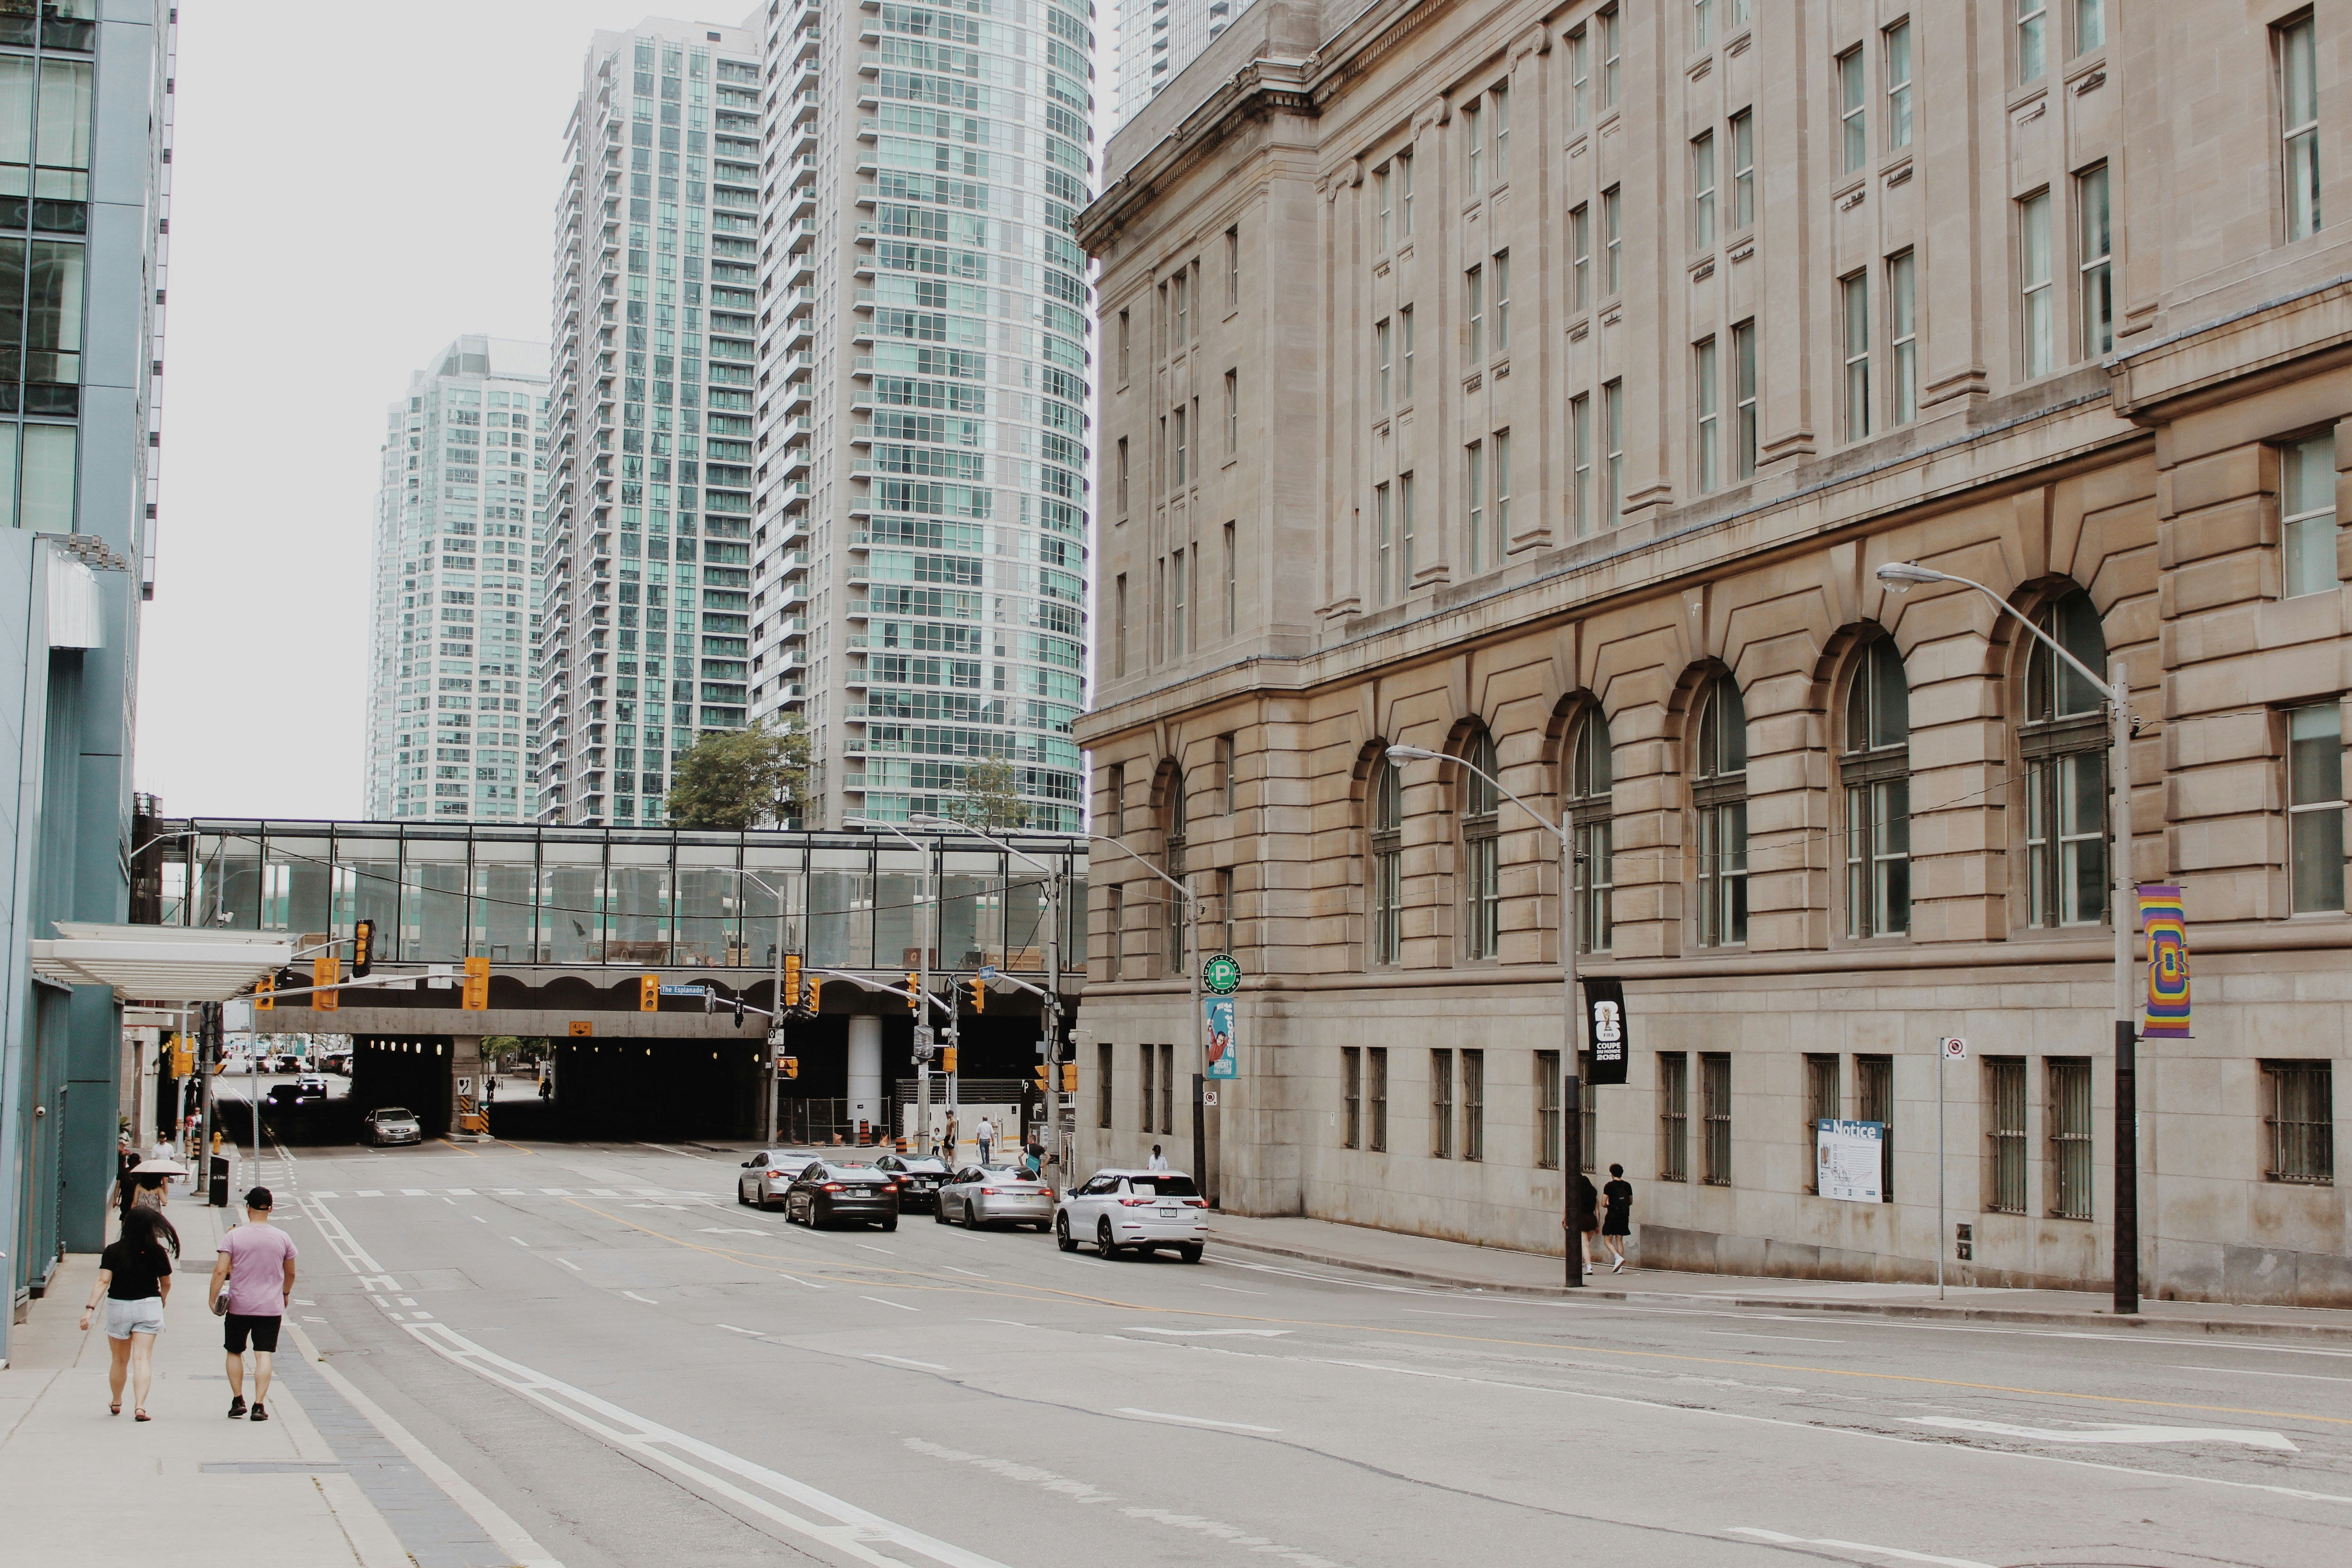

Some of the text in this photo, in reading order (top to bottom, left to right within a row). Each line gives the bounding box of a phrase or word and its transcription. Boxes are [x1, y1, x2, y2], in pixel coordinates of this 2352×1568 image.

[1205, 956, 1239, 974] MUNICIPAL
[1215, 965, 1230, 981] P
[1205, 978, 1240, 994] PARKING
[1833, 1119, 1877, 1139] Notice
